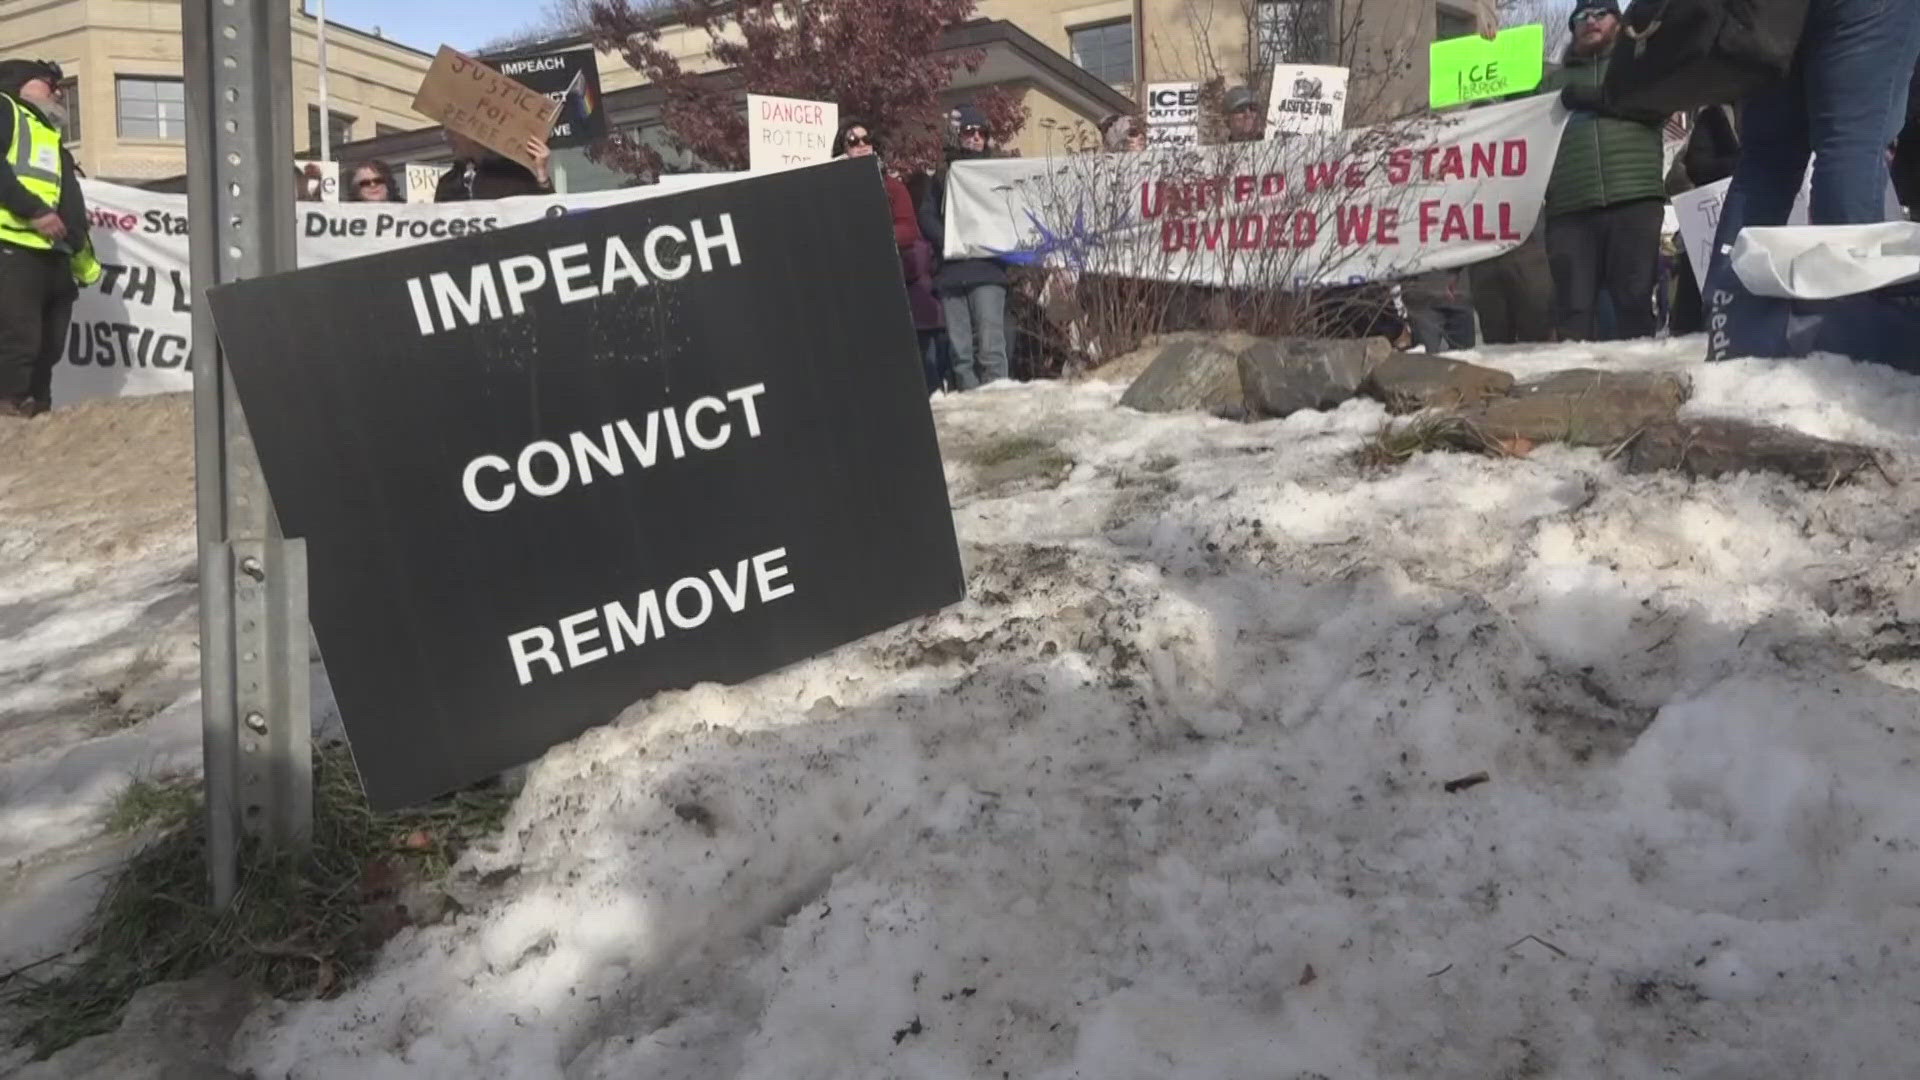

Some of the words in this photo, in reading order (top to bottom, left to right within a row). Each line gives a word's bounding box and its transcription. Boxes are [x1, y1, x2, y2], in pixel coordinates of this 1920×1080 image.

[501, 56, 565, 75] IMPEACH
[1458, 61, 1498, 84] ICE
[451, 56, 549, 122] JUSTICE
[1149, 90, 1199, 107] ICE
[761, 101, 824, 126] DANGER
[1149, 109, 1177, 117] OUT
[762, 127, 826, 150] ROTTEN
[1141, 173, 1285, 219] UNITED
[1305, 159, 1367, 194] WE
[1387, 138, 1527, 185] STAND
[88, 207, 138, 232] ine
[143, 209, 190, 236] Sta
[305, 212, 367, 238] Due
[375, 213, 497, 238] Process
[1162, 210, 1317, 253] DIVIDED
[1336, 203, 1399, 247] WE
[1419, 200, 1521, 243] FALL
[406, 212, 743, 337] IMPEACH
[67, 320, 193, 372] USTIC
[462, 382, 766, 512] CONVICT
[507, 546, 795, 686] REMOVE
